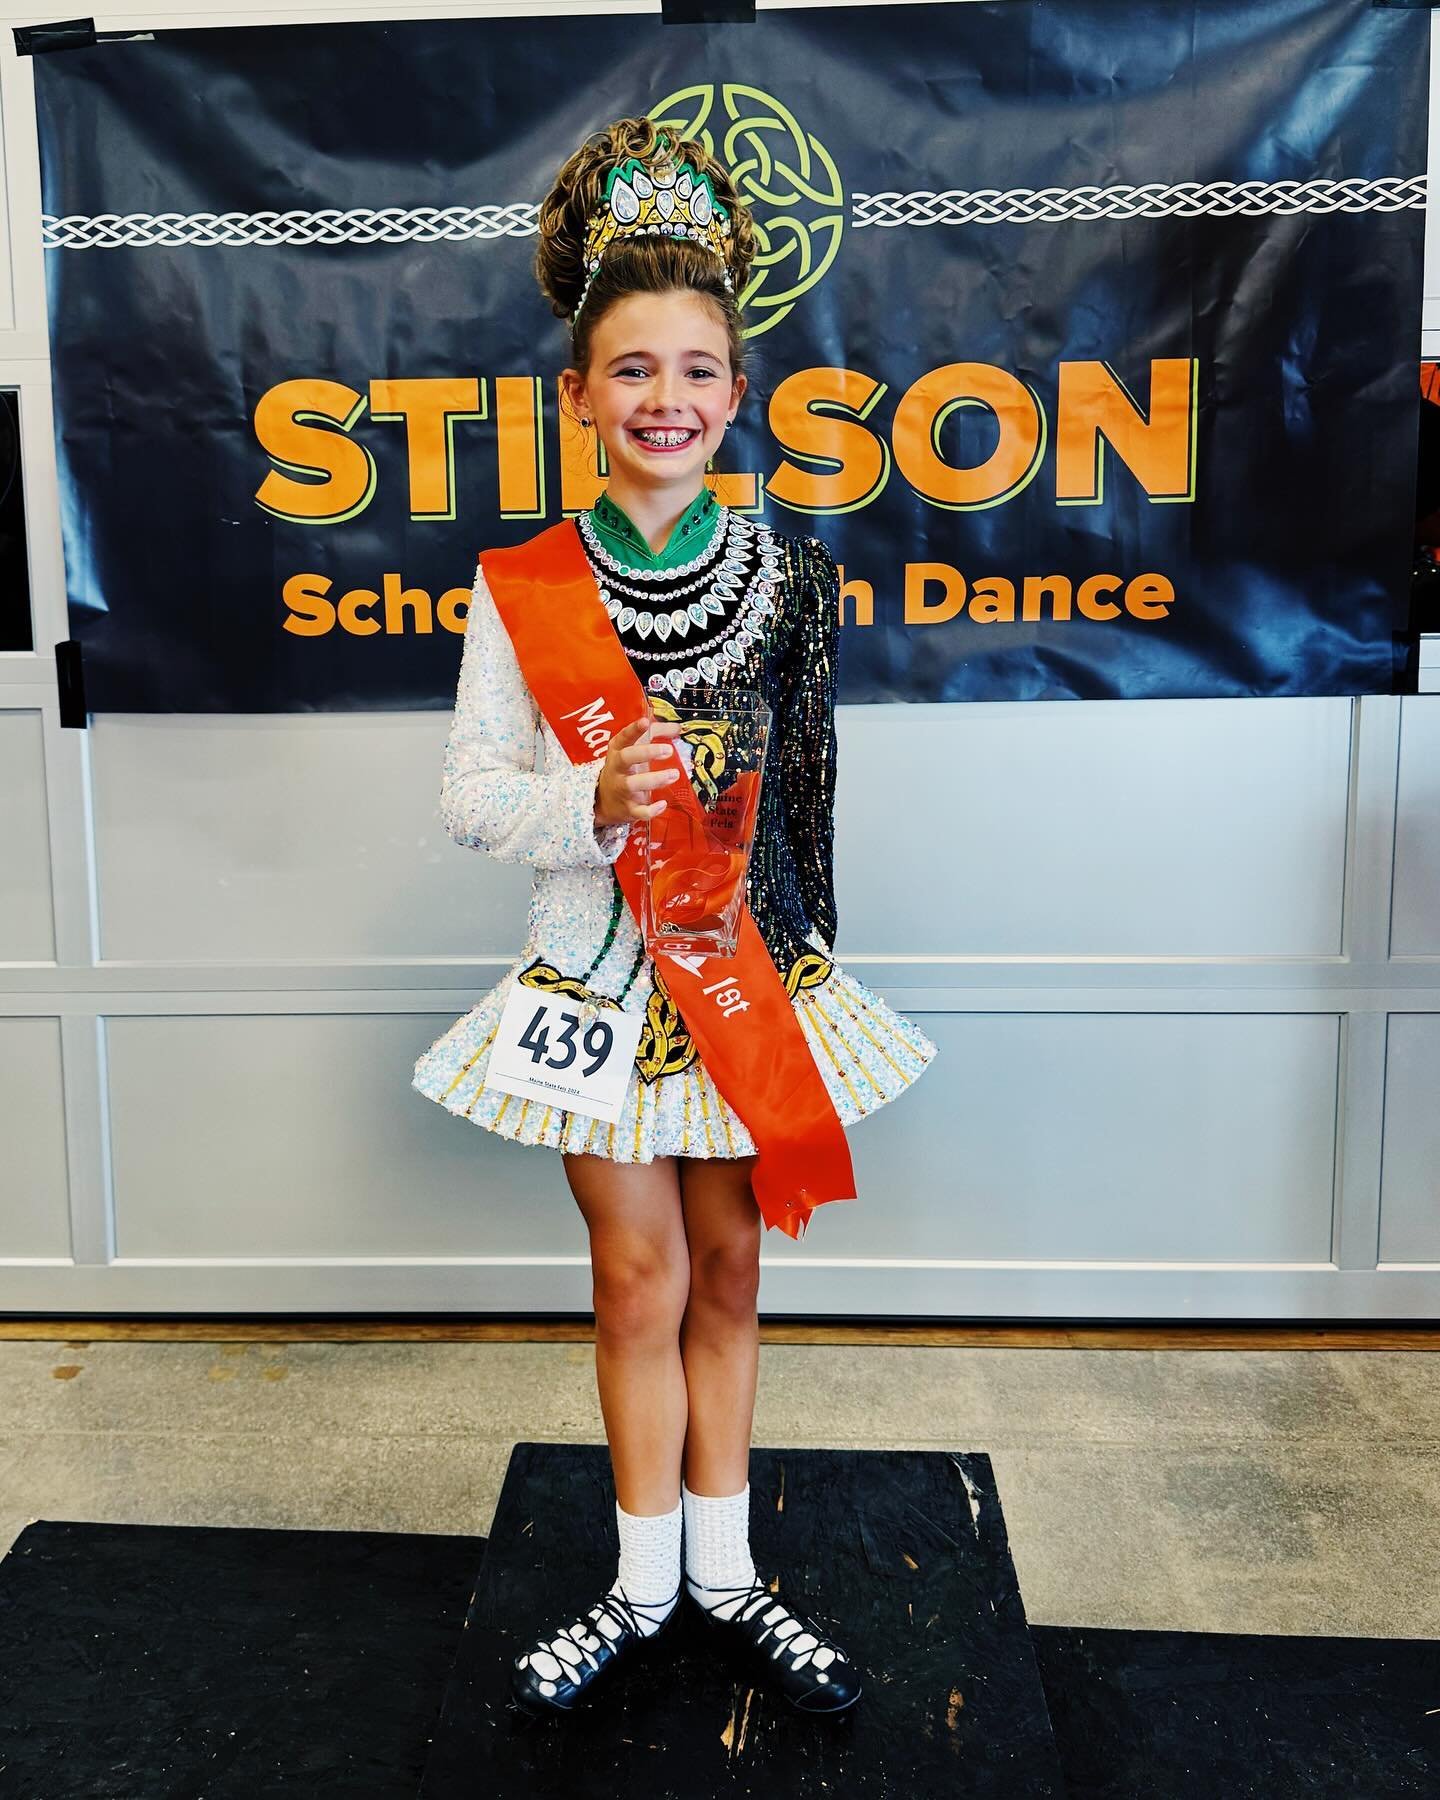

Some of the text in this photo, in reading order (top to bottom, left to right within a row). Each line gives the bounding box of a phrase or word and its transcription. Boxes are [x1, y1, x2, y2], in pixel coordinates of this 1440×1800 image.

[254, 358, 1198, 526] STILSON
[904, 562, 1176, 626] Dance
[702, 976, 751, 1018] 1st
[517, 1005, 614, 1078] 439
